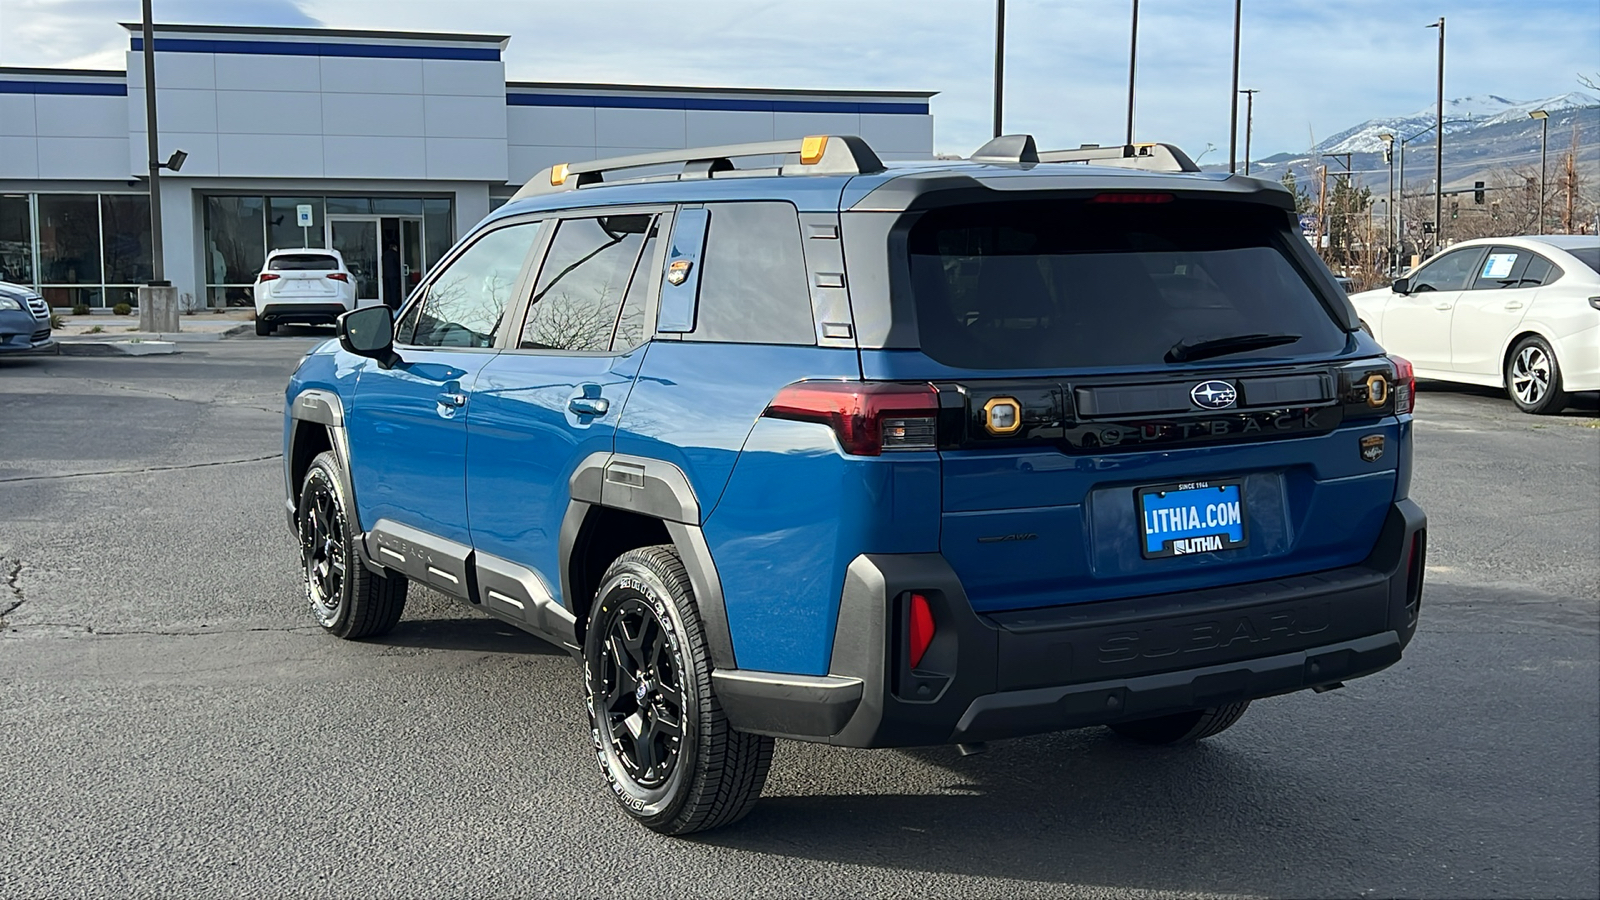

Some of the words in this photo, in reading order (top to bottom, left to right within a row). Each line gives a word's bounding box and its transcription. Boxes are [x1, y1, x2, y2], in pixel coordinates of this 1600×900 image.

[1100, 412, 1321, 444] OUTBACK
[1178, 482, 1196, 491] SINCE
[1144, 501, 1241, 535] LITHIA.COM
[1184, 535, 1223, 554] LITHIA
[1098, 602, 1332, 663] SUBARU
